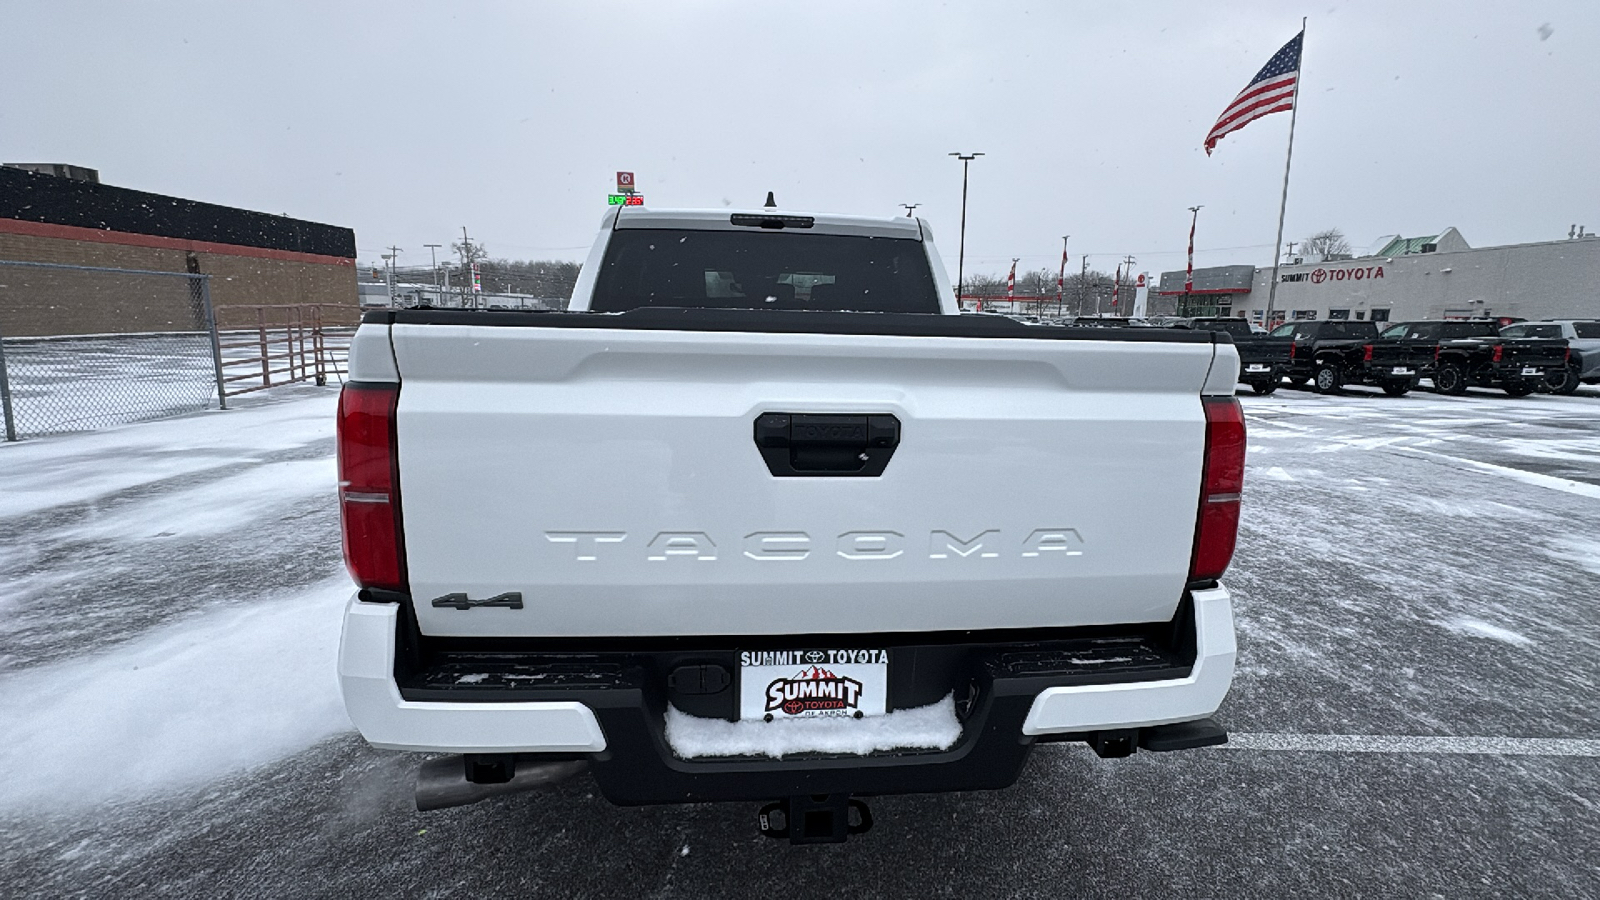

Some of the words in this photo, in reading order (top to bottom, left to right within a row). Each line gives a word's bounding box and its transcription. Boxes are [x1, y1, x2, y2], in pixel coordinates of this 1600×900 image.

[1281, 272, 1310, 283] SUMMIT
[1328, 266, 1384, 281] TOYOTA
[794, 425, 864, 439] TOYOTA
[544, 526, 1084, 562] TACOMA
[741, 651, 803, 666] SUMMIT
[828, 649, 889, 664] TOYOTA
[768, 680, 859, 708] SUMMIT
[805, 700, 845, 709] TOYOTA
